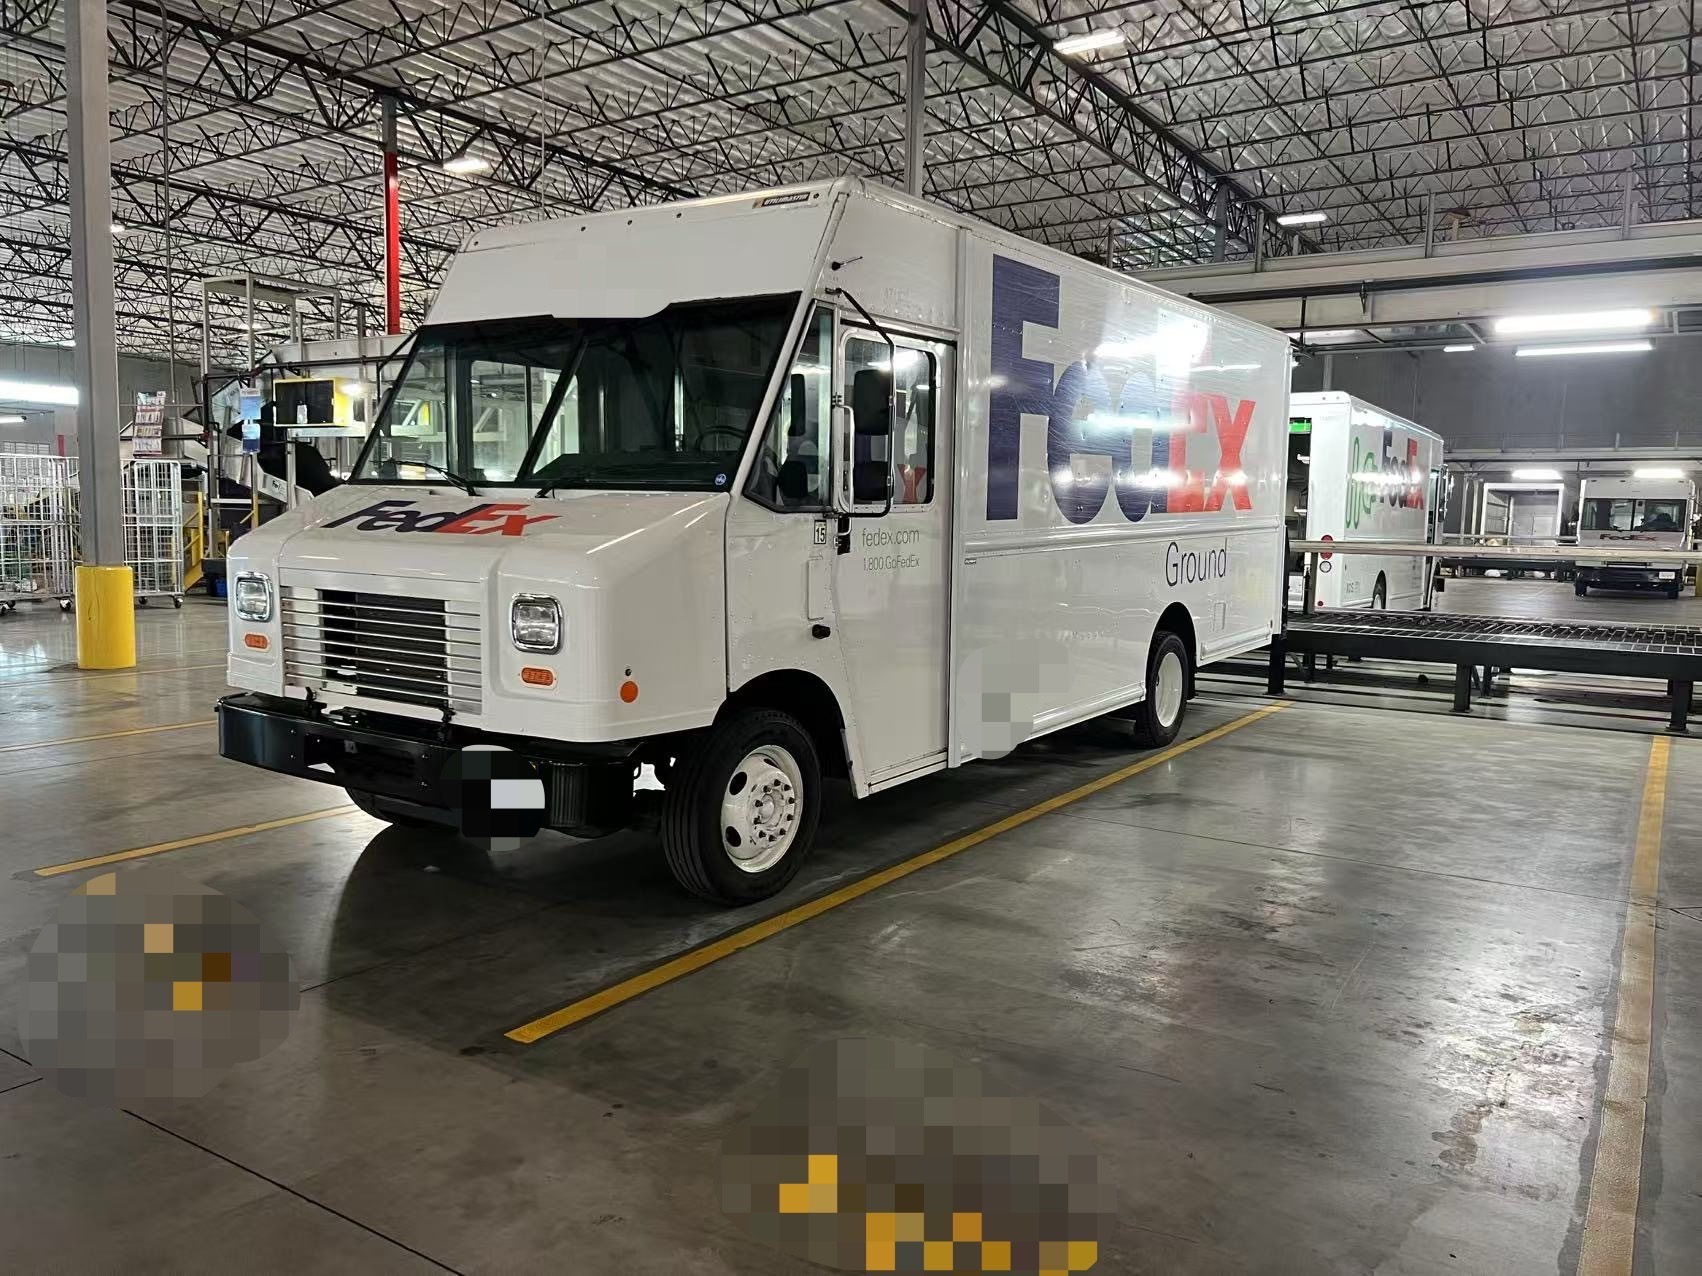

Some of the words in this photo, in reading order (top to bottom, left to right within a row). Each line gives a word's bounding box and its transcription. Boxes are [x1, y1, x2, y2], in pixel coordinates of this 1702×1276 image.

[320, 500, 563, 536] FedEx
[815, 527, 825, 543] 15
[862, 528, 920, 547] fedex.com
[1165, 537, 1228, 587] Ground
